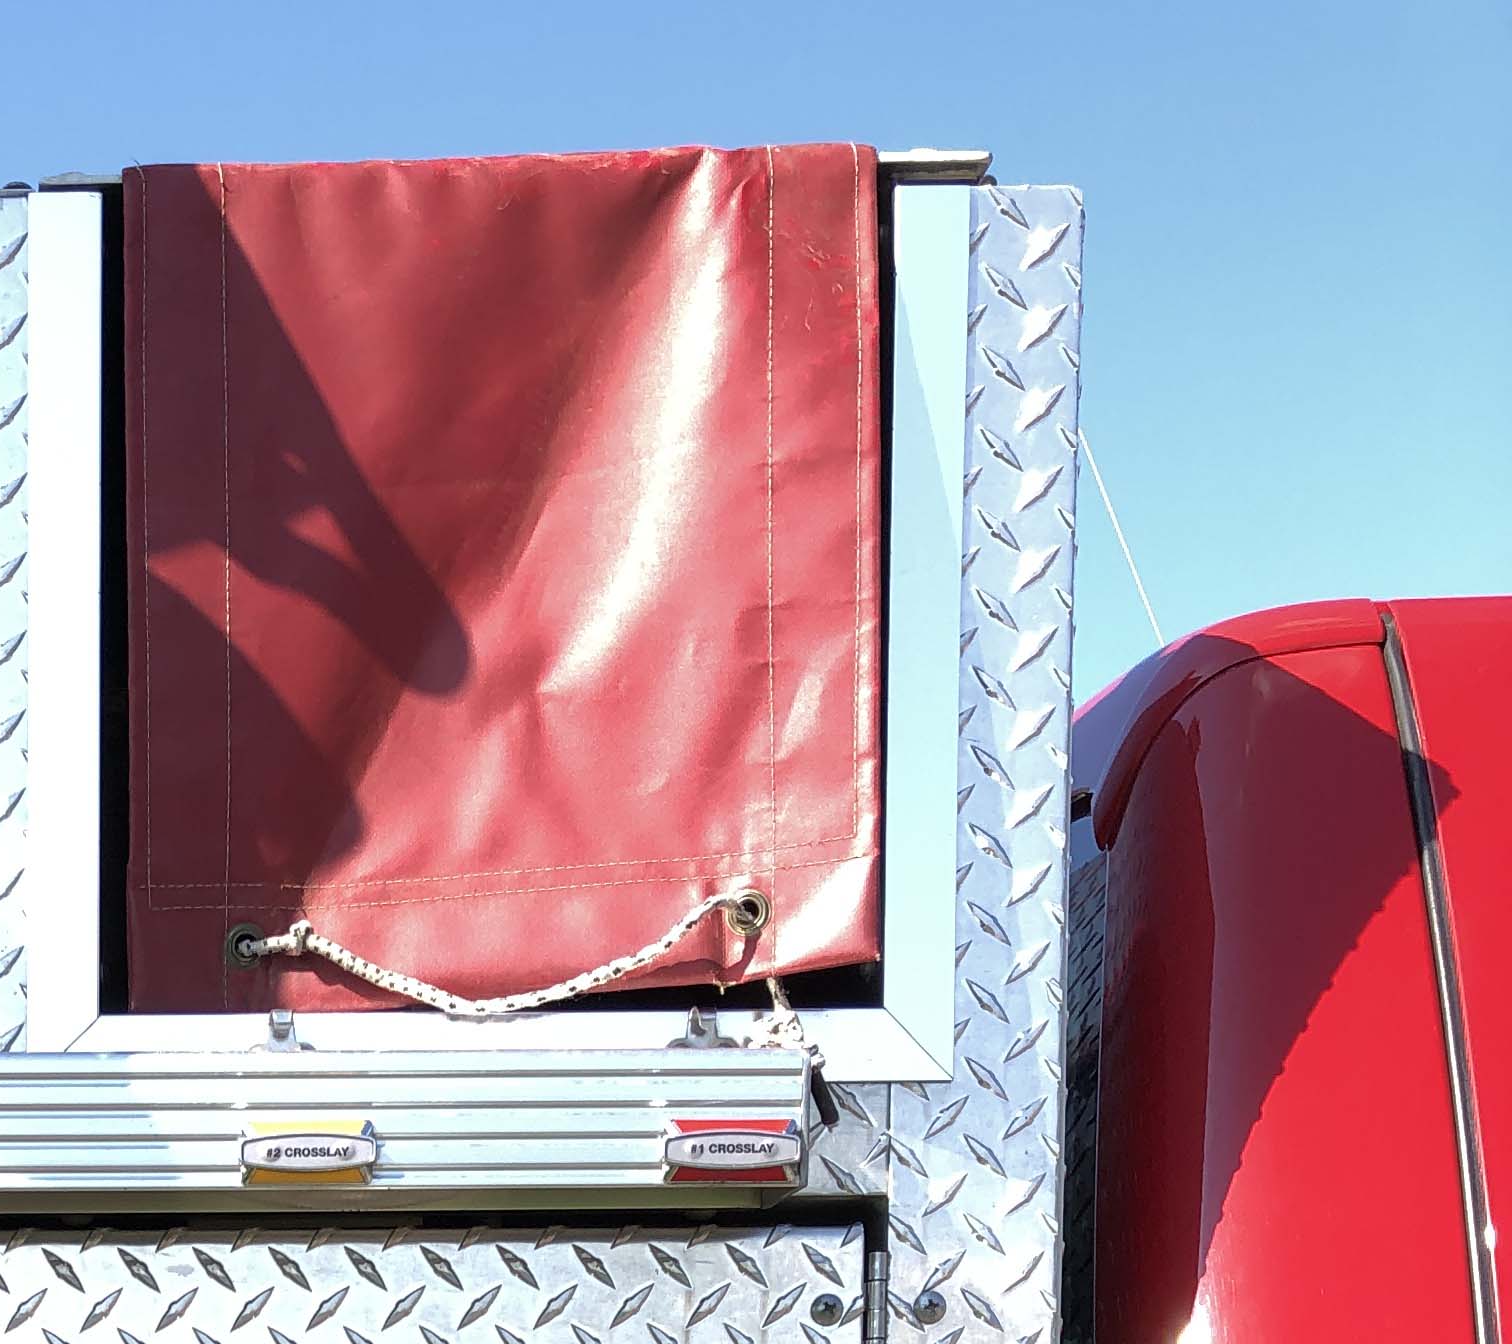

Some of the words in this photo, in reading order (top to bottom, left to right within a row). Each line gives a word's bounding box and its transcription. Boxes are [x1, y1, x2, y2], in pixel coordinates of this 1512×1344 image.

[266, 1147, 281, 1158] #2
[284, 1146, 350, 1158] CROSSLAY
[691, 1144, 705, 1154] #1
[708, 1143, 775, 1154] CROSSLAY
